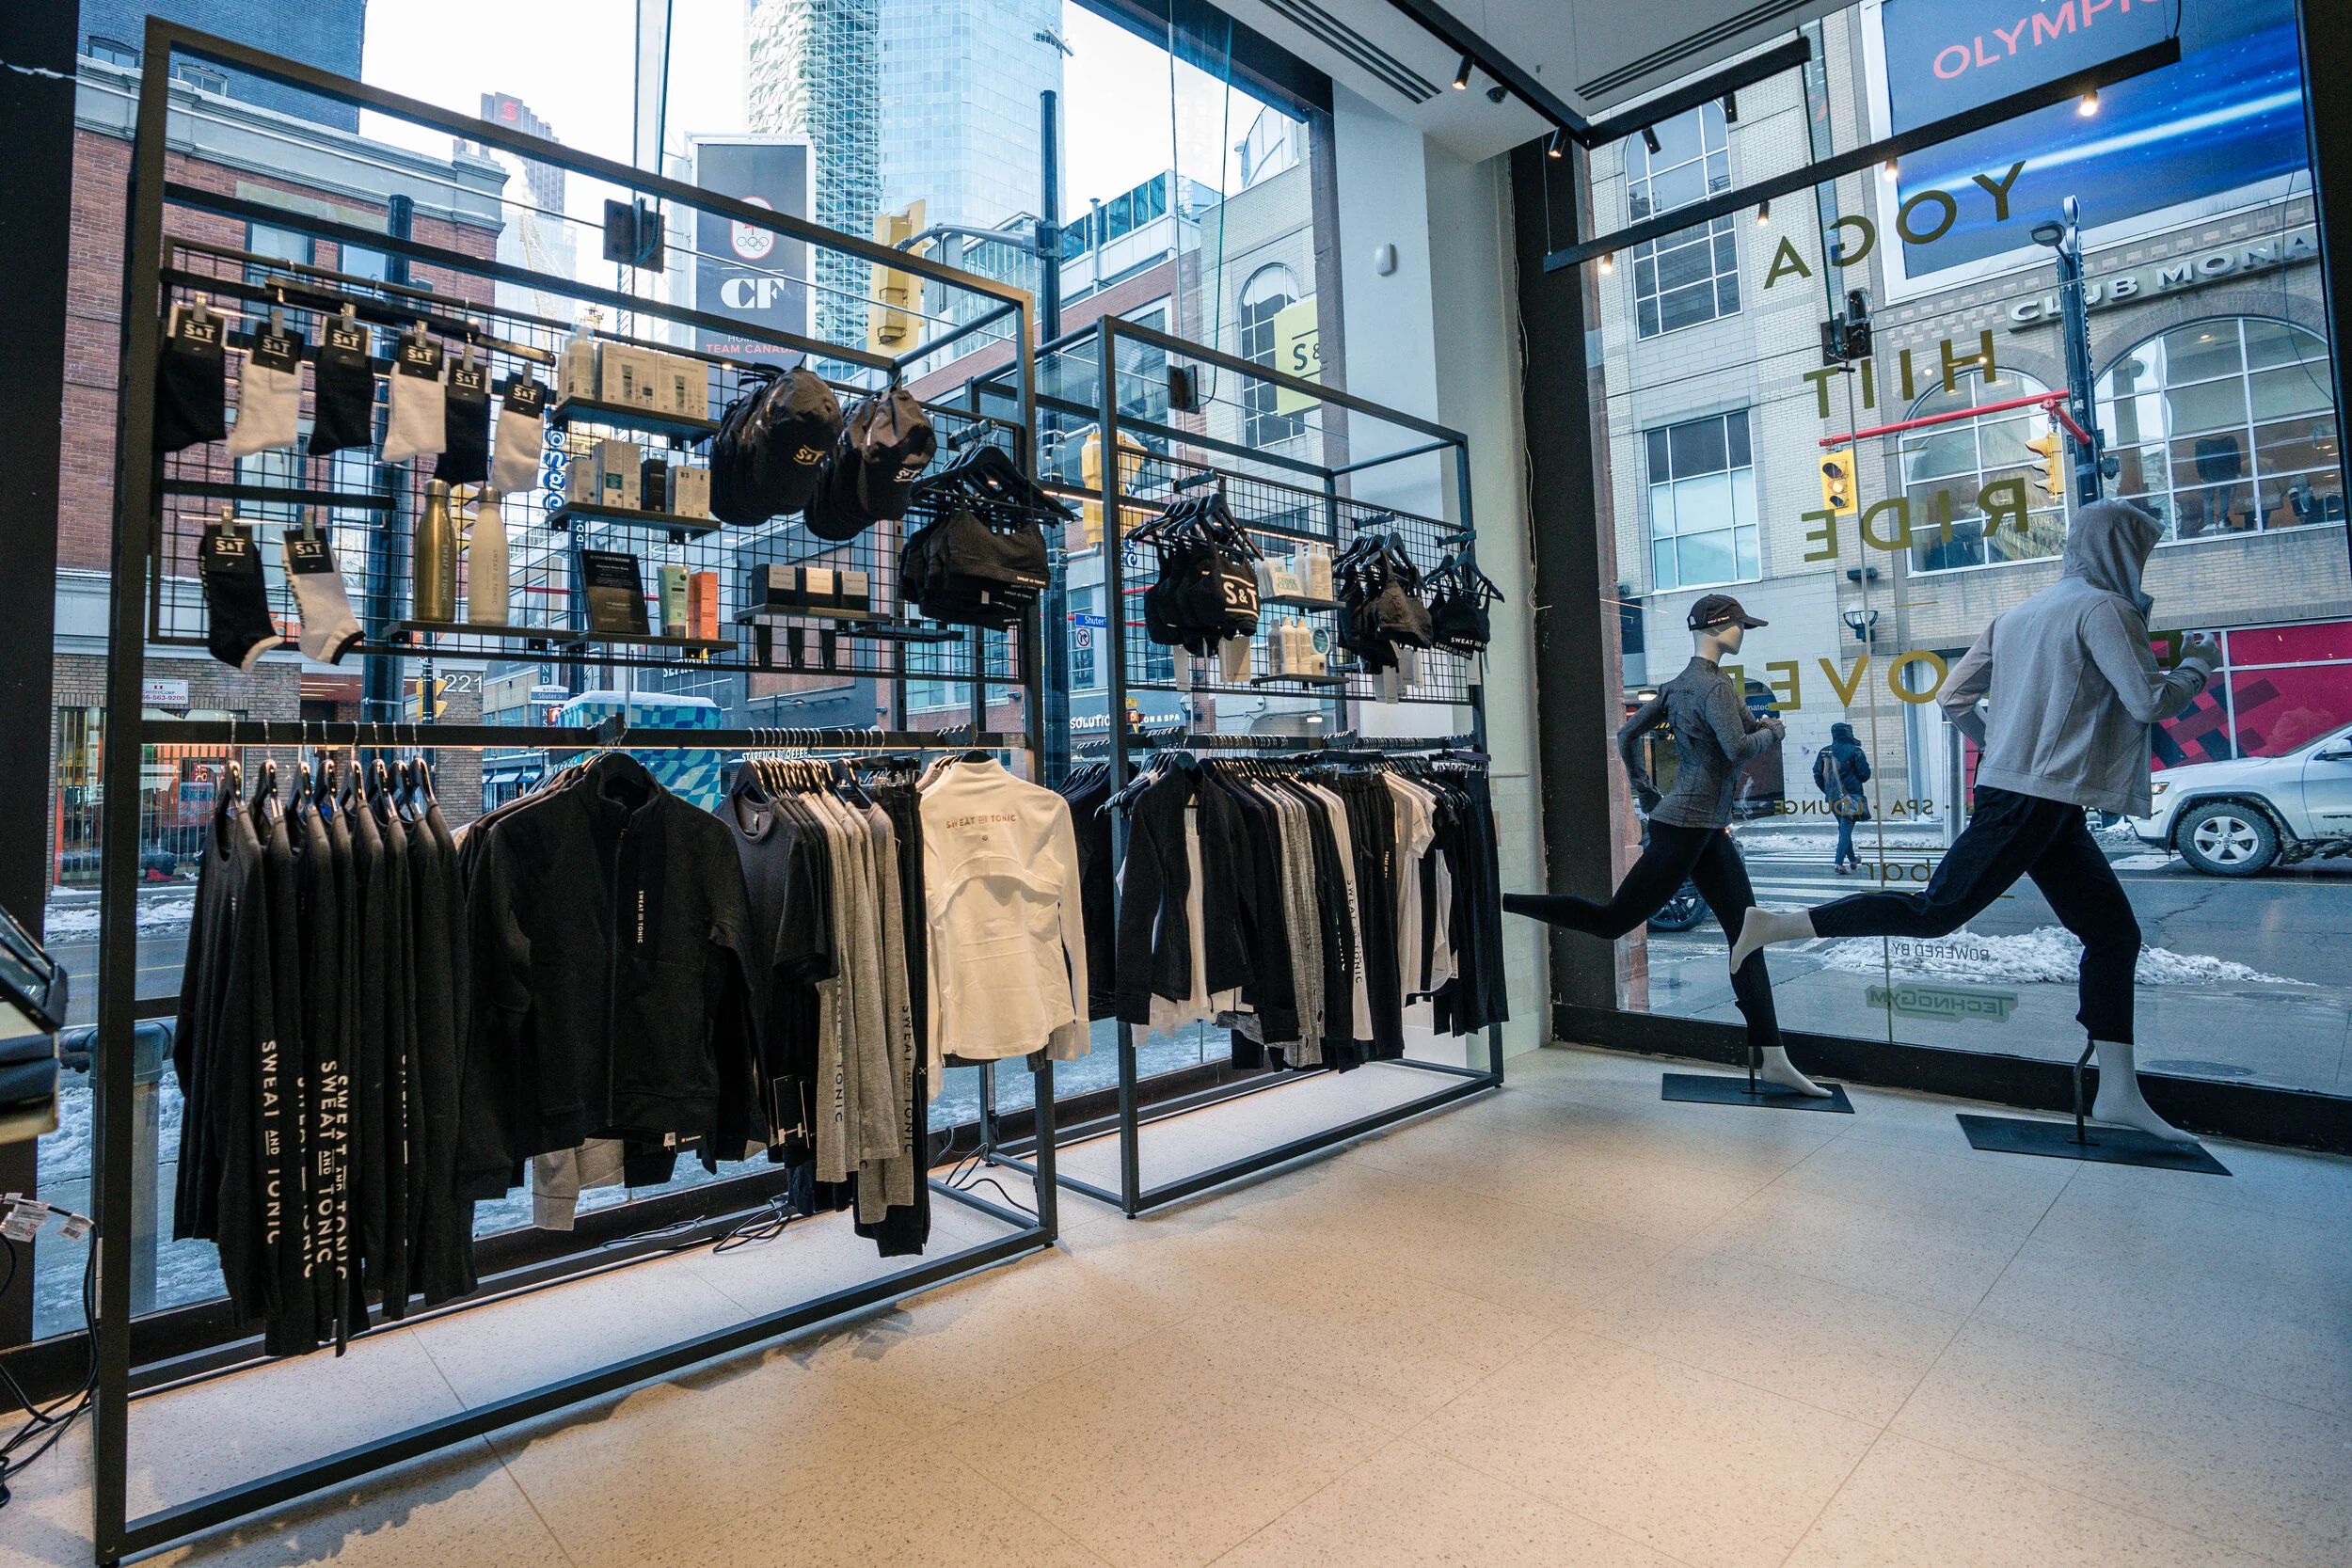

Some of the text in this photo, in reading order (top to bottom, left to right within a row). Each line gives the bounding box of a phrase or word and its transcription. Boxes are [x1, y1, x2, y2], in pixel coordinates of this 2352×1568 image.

[1932, 0, 2159, 79] OLYMP
[721, 277, 785, 309] CF
[707, 344, 740, 354] TEAM
[1223, 580, 1259, 610] S&T
[1084, 615, 1104, 626] Shuter
[1450, 637, 1473, 645] SWEAT
[443, 673, 483, 693] 221
[946, 816, 975, 829] SWEAT
[902, 1005, 912, 1061] SWEAT
[262, 1039, 280, 1117] SWEAT
[336, 1074, 349, 1155] SWEAT
[904, 1099, 913, 1154] TONIC
[269, 1130, 280, 1155] AND
[316, 1060, 338, 1264] SWEAT AND TONIC
